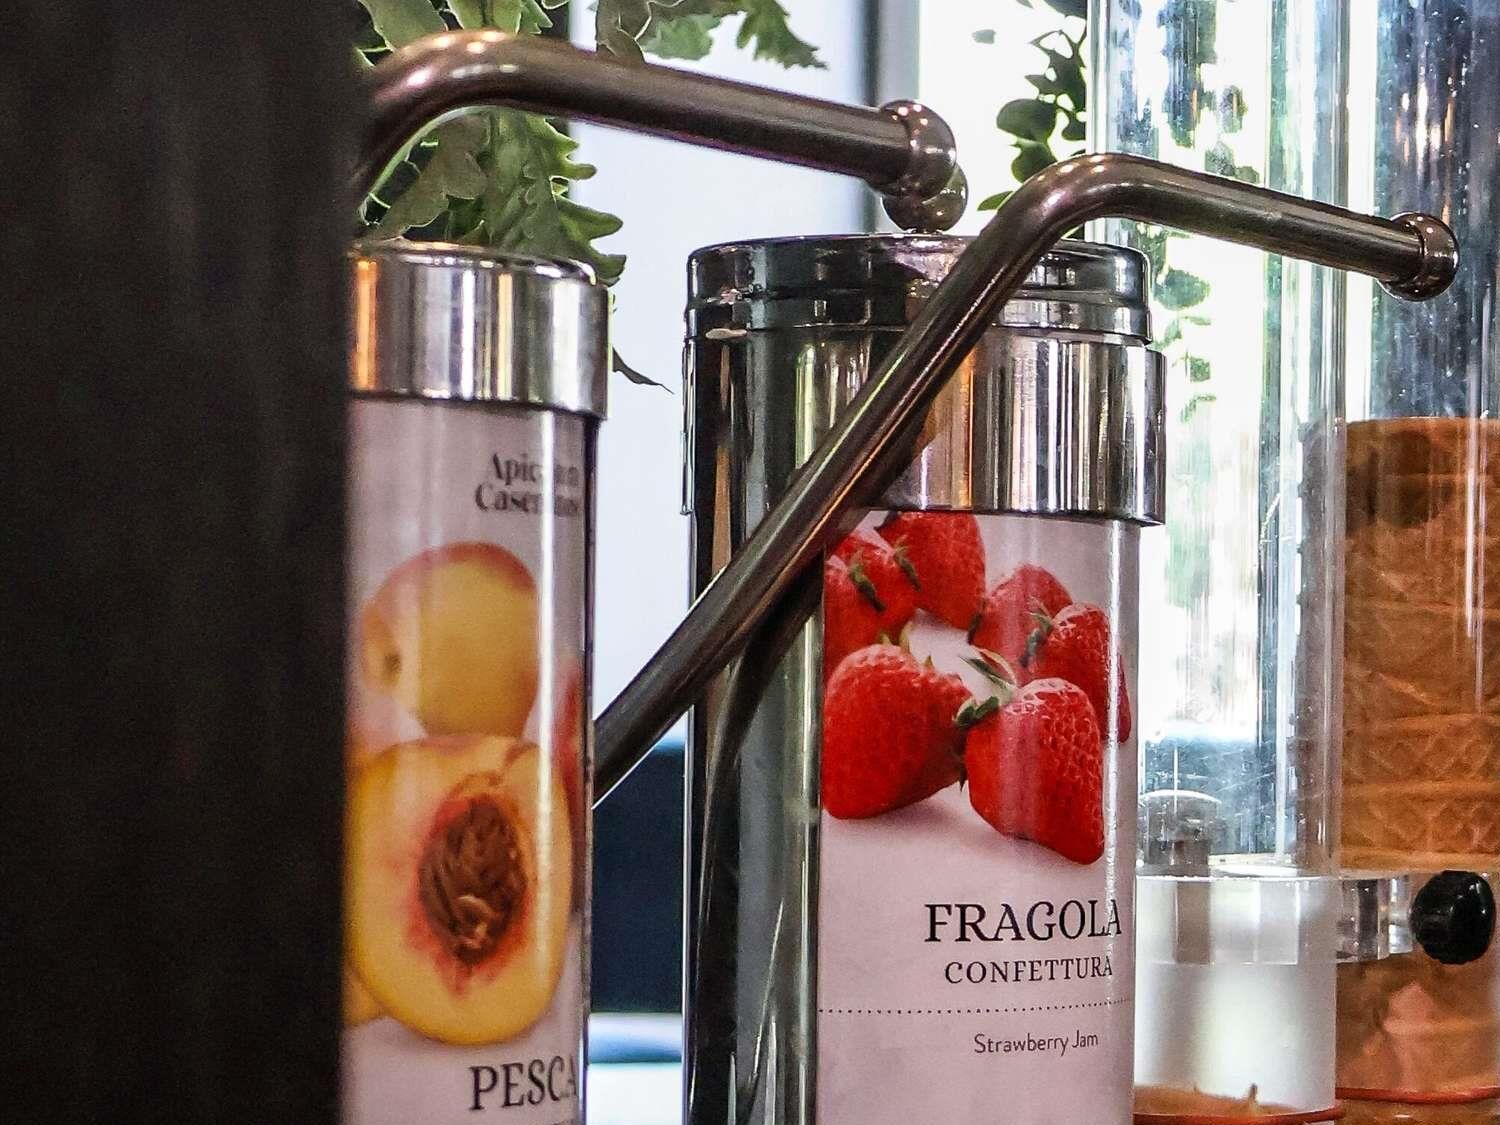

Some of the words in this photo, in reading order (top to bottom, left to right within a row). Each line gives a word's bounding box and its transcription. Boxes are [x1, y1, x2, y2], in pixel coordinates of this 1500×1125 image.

[924, 899, 1122, 942] FRAGOLA
[944, 955, 1113, 984] CONFETTURA
[973, 1032, 1069, 1056] Strawberry
[1071, 1029, 1099, 1049] Jam
[468, 1055, 578, 1111] PESCA
